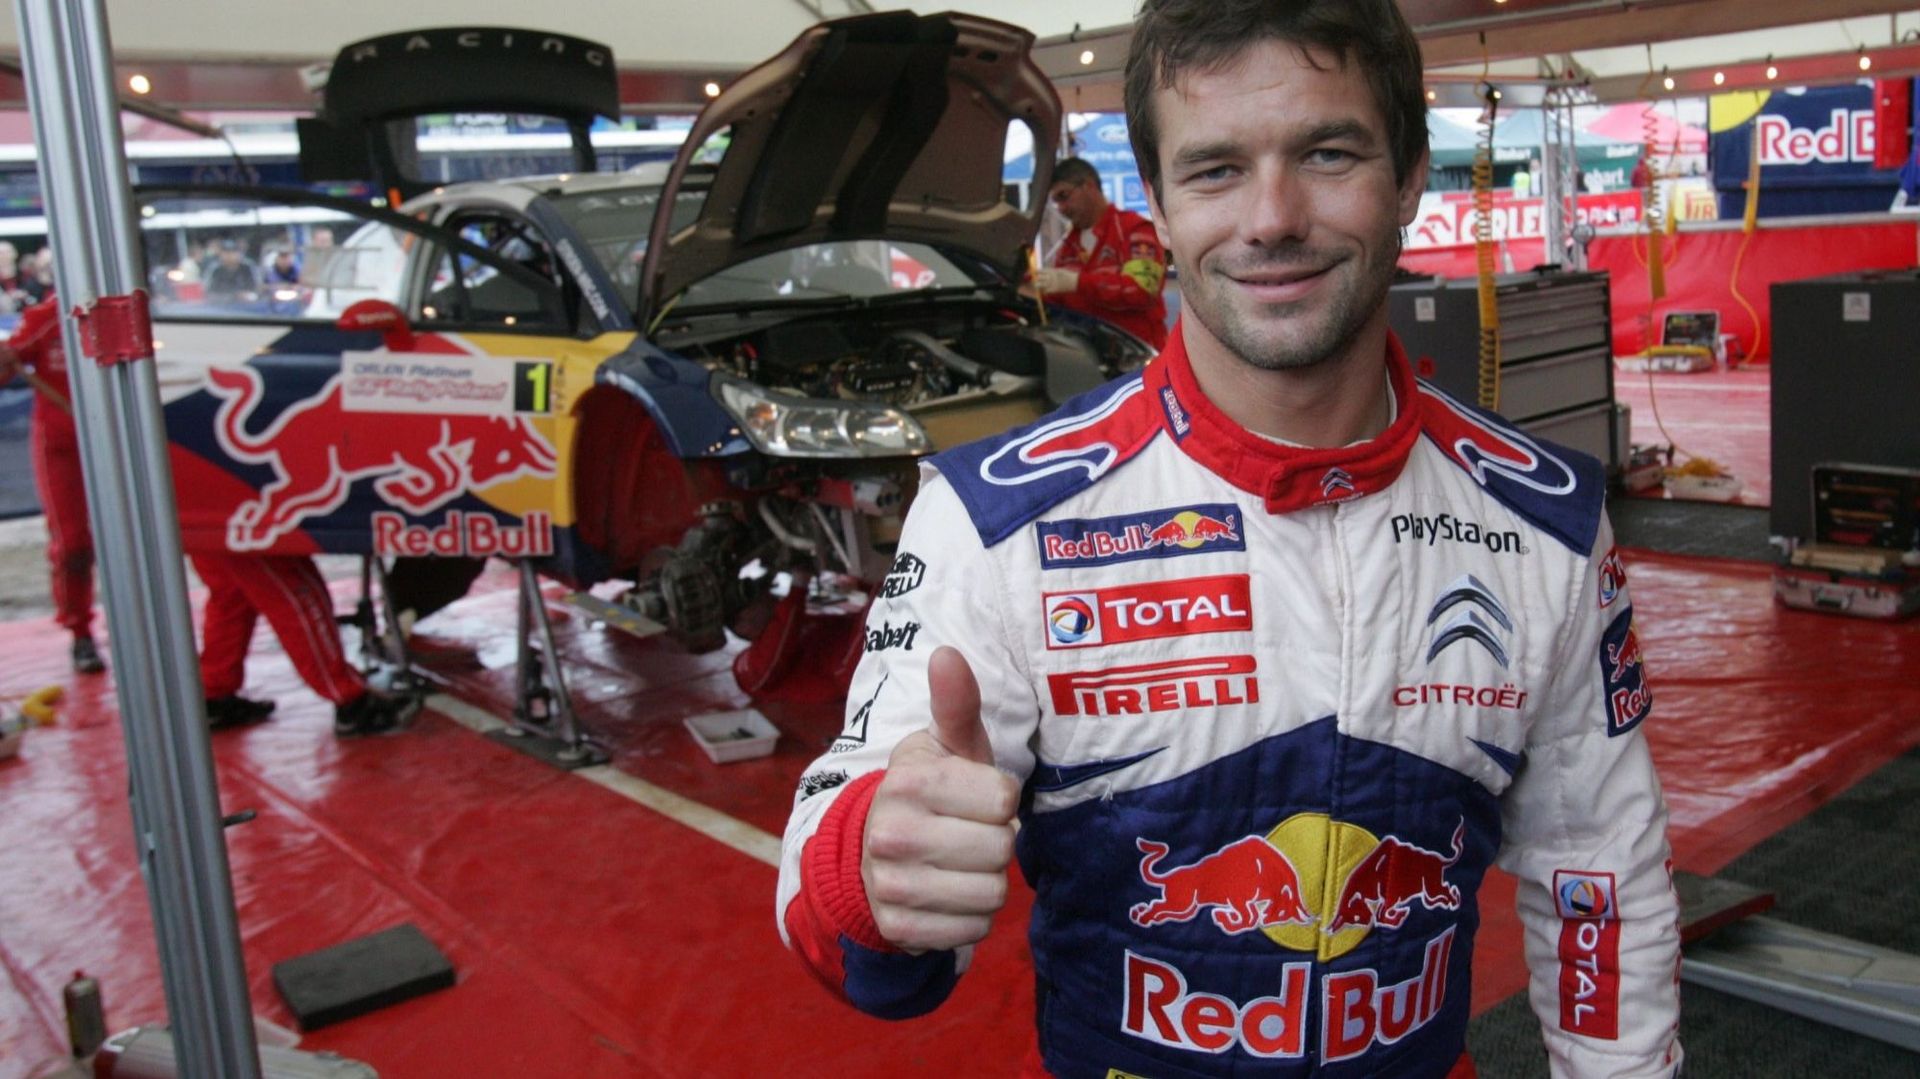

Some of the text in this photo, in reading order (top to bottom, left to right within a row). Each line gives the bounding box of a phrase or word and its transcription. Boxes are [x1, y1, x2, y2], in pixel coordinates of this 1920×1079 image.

[1756, 108, 1849, 165] Red
[526, 362, 548, 412] 1
[372, 512, 554, 556] Red Bull
[1044, 524, 1144, 561] Red Bull
[1392, 512, 1521, 554] PlayStaon
[1104, 593, 1247, 629] TOTAL
[1047, 654, 1260, 717] PIRELLI
[1121, 924, 1457, 1066] Red Bull
[1573, 918, 1606, 1027] OTAL
